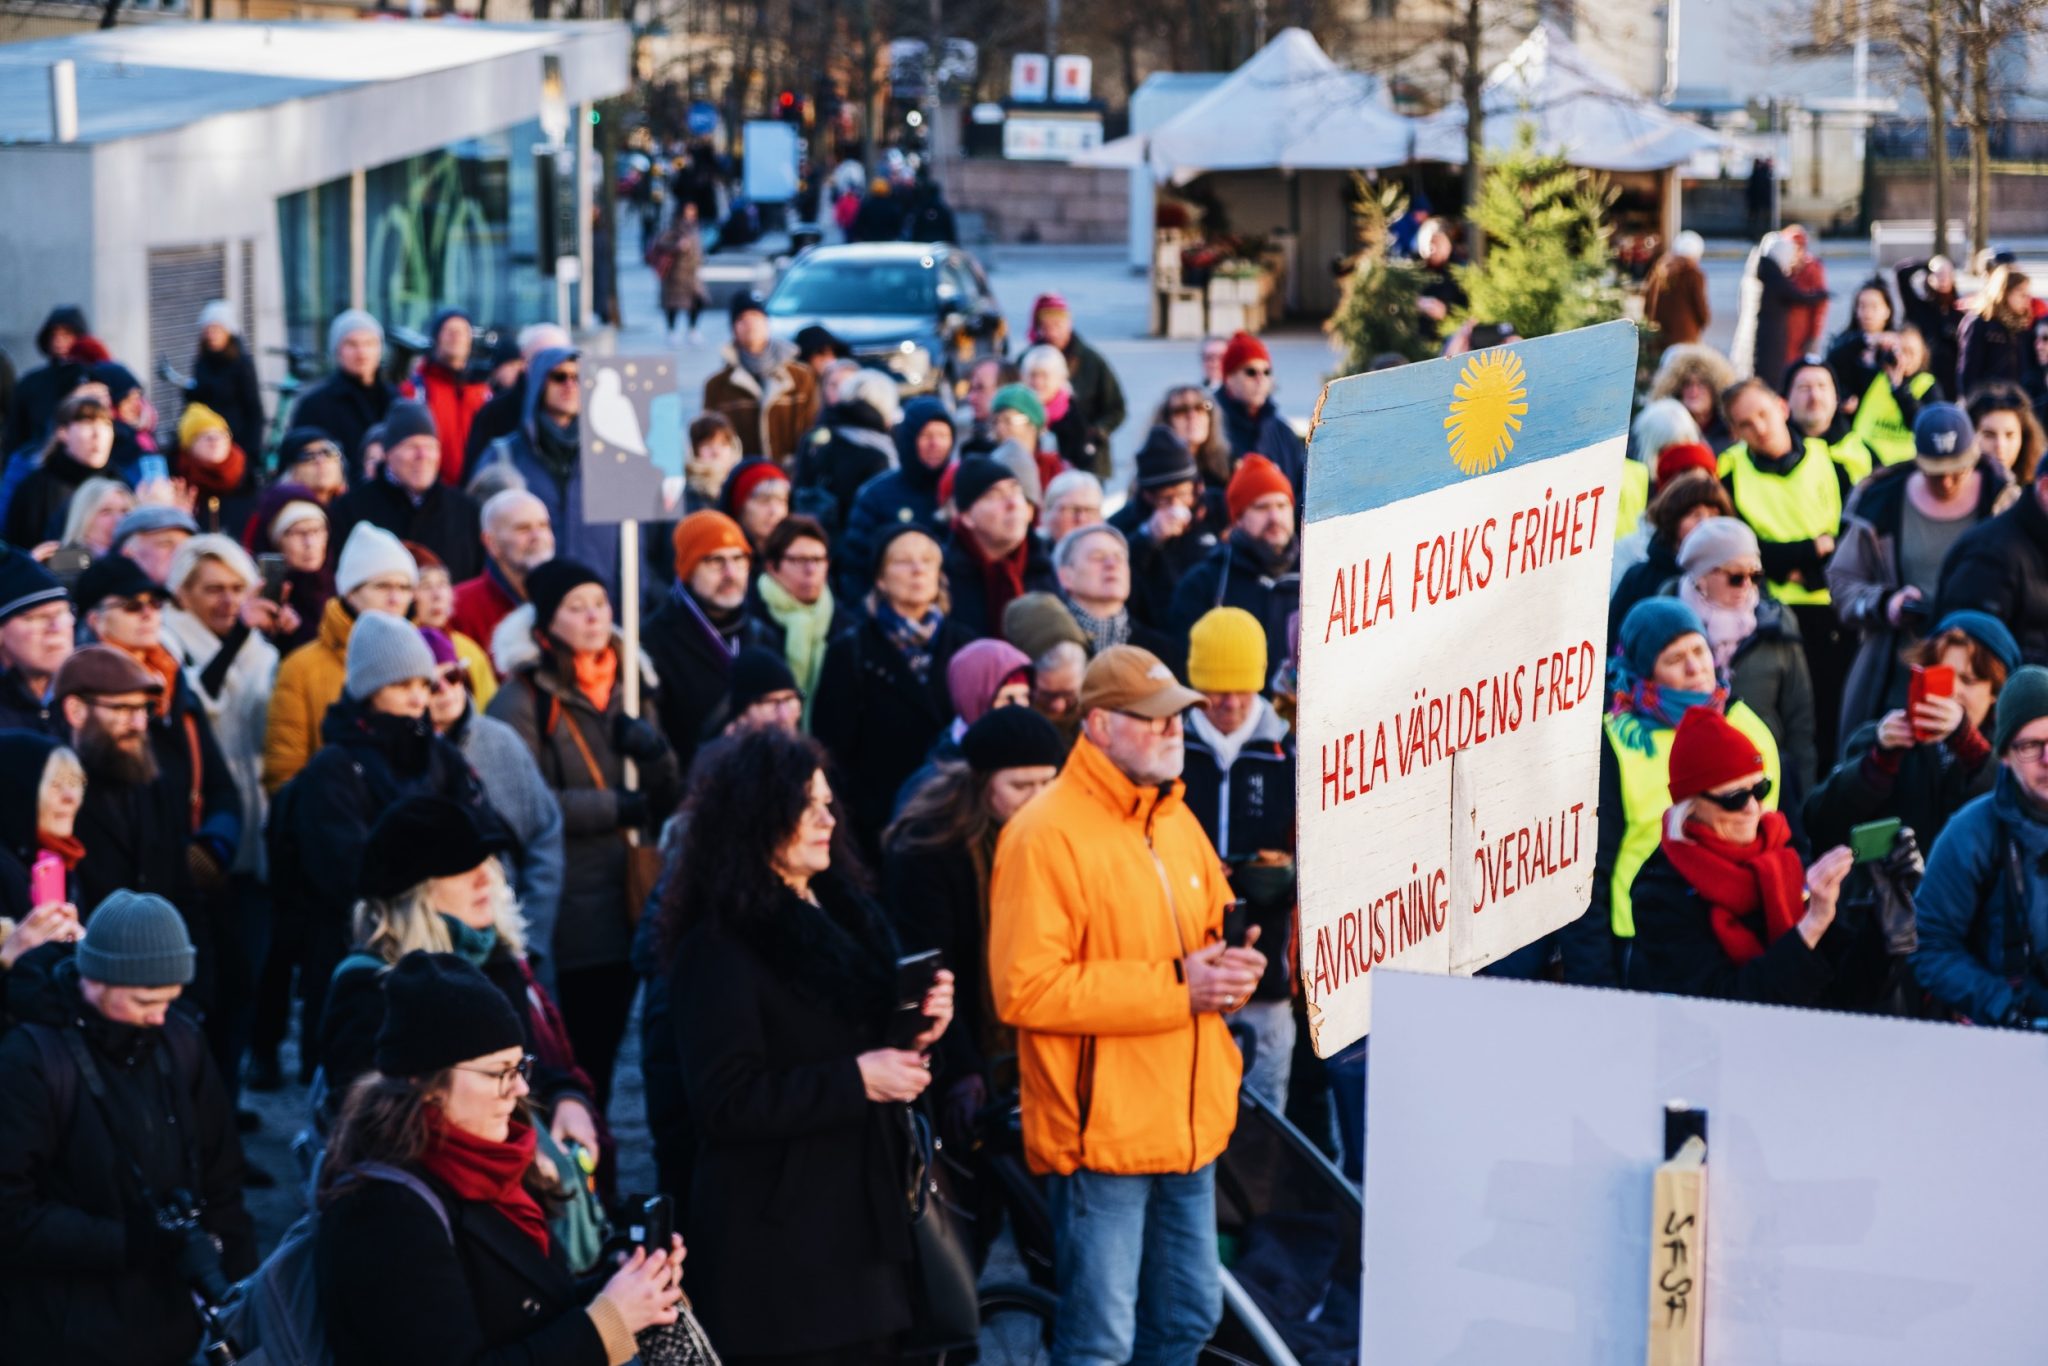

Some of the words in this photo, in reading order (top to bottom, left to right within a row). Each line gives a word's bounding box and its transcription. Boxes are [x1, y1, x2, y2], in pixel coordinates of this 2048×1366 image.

[1324, 552, 1395, 644] ALLA
[1410, 517, 1498, 612] FOLKS
[1321, 720, 1389, 811] HELA
[1395, 664, 1526, 777] VÄRLDENS
[1532, 640, 1596, 722] FRED
